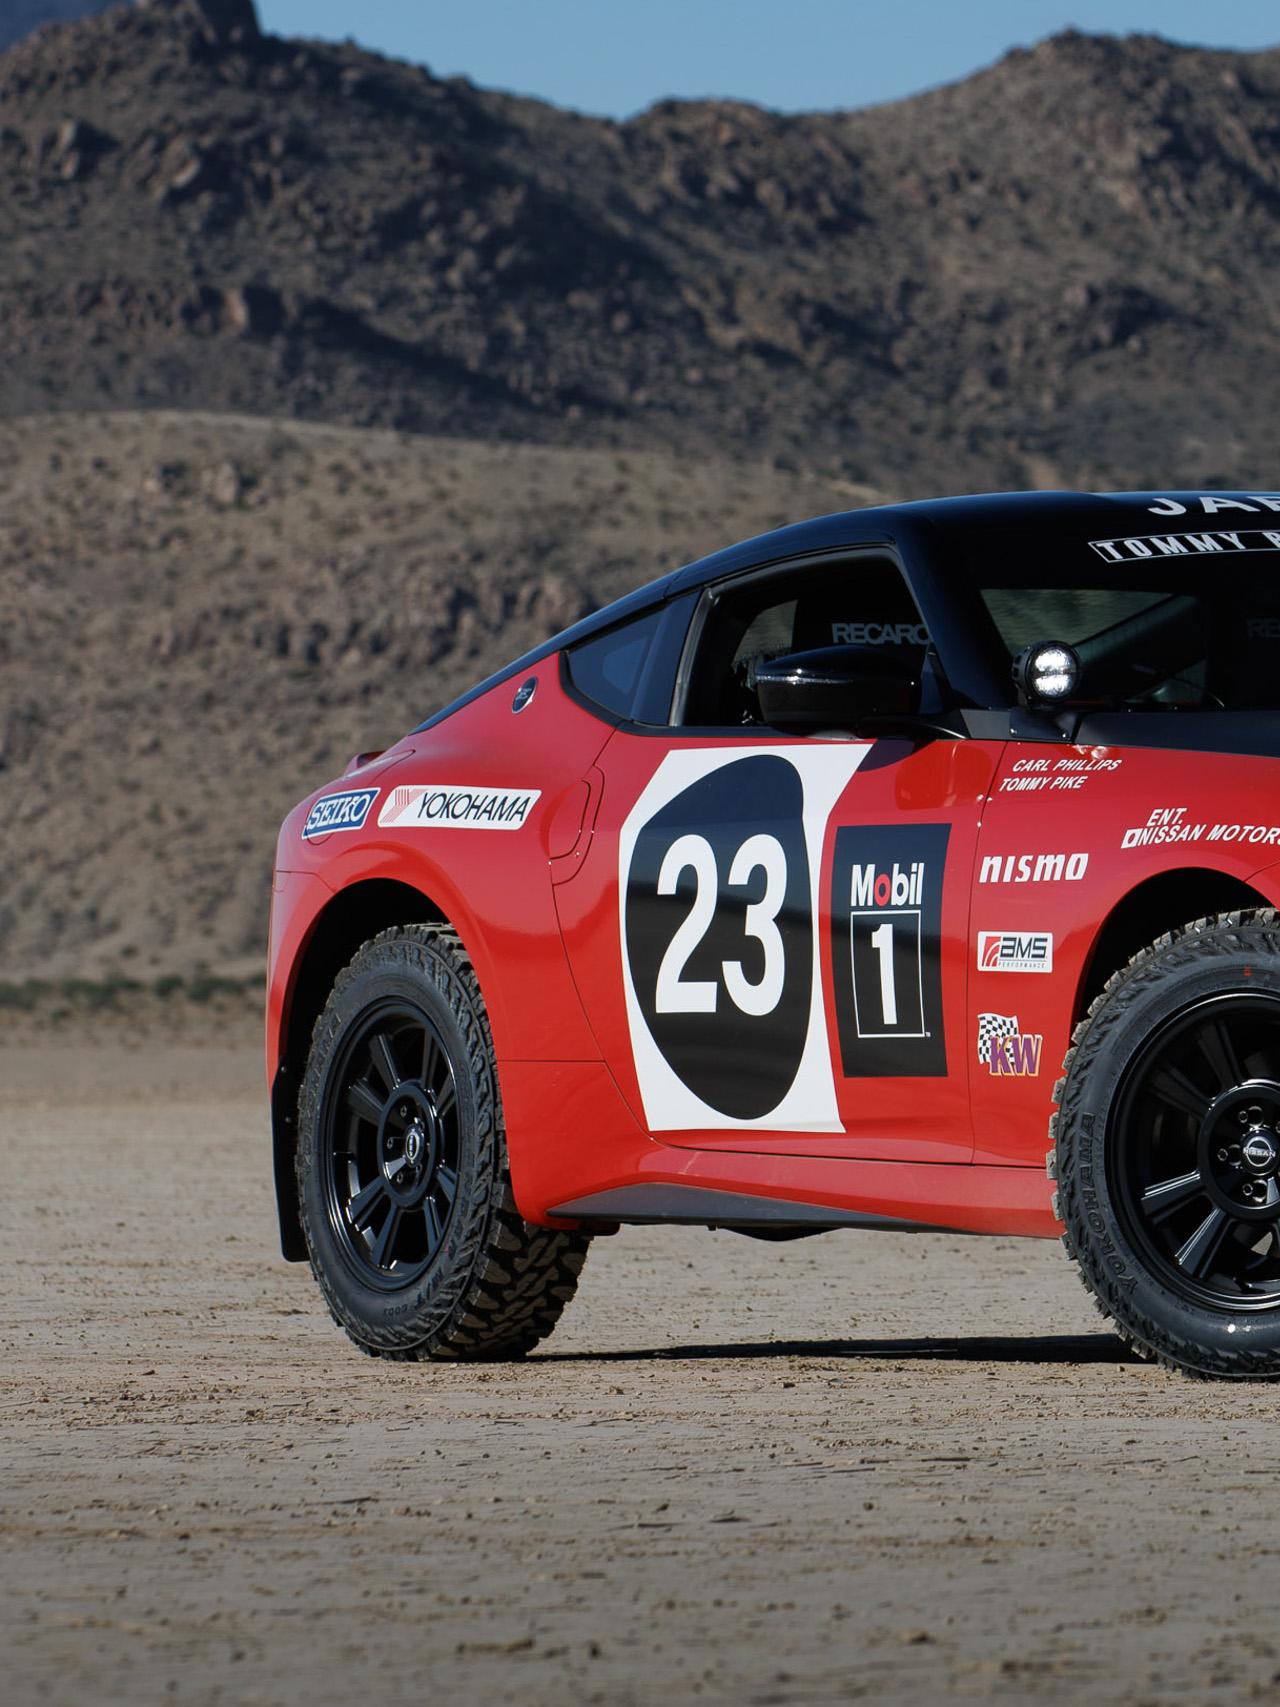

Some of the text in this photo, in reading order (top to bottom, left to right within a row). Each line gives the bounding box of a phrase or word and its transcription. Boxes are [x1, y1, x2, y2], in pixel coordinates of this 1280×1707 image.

[1095, 532, 1243, 559] TOMMY
[831, 622, 934, 646] RECARO
[1012, 758, 1123, 773] CARL PHILLIPS
[999, 775, 1088, 792] TOMMY PIKE
[306, 793, 372, 830] SEIKO
[417, 792, 532, 822] YOKOHAMA
[1147, 807, 1188, 827] ENT.
[1138, 824, 1206, 846] NISSAN
[850, 862, 926, 907] Mobil
[655, 833, 788, 1017] 23
[871, 922, 899, 1025] 1
[1079, 1111, 1138, 1296] YOKOHAMA
